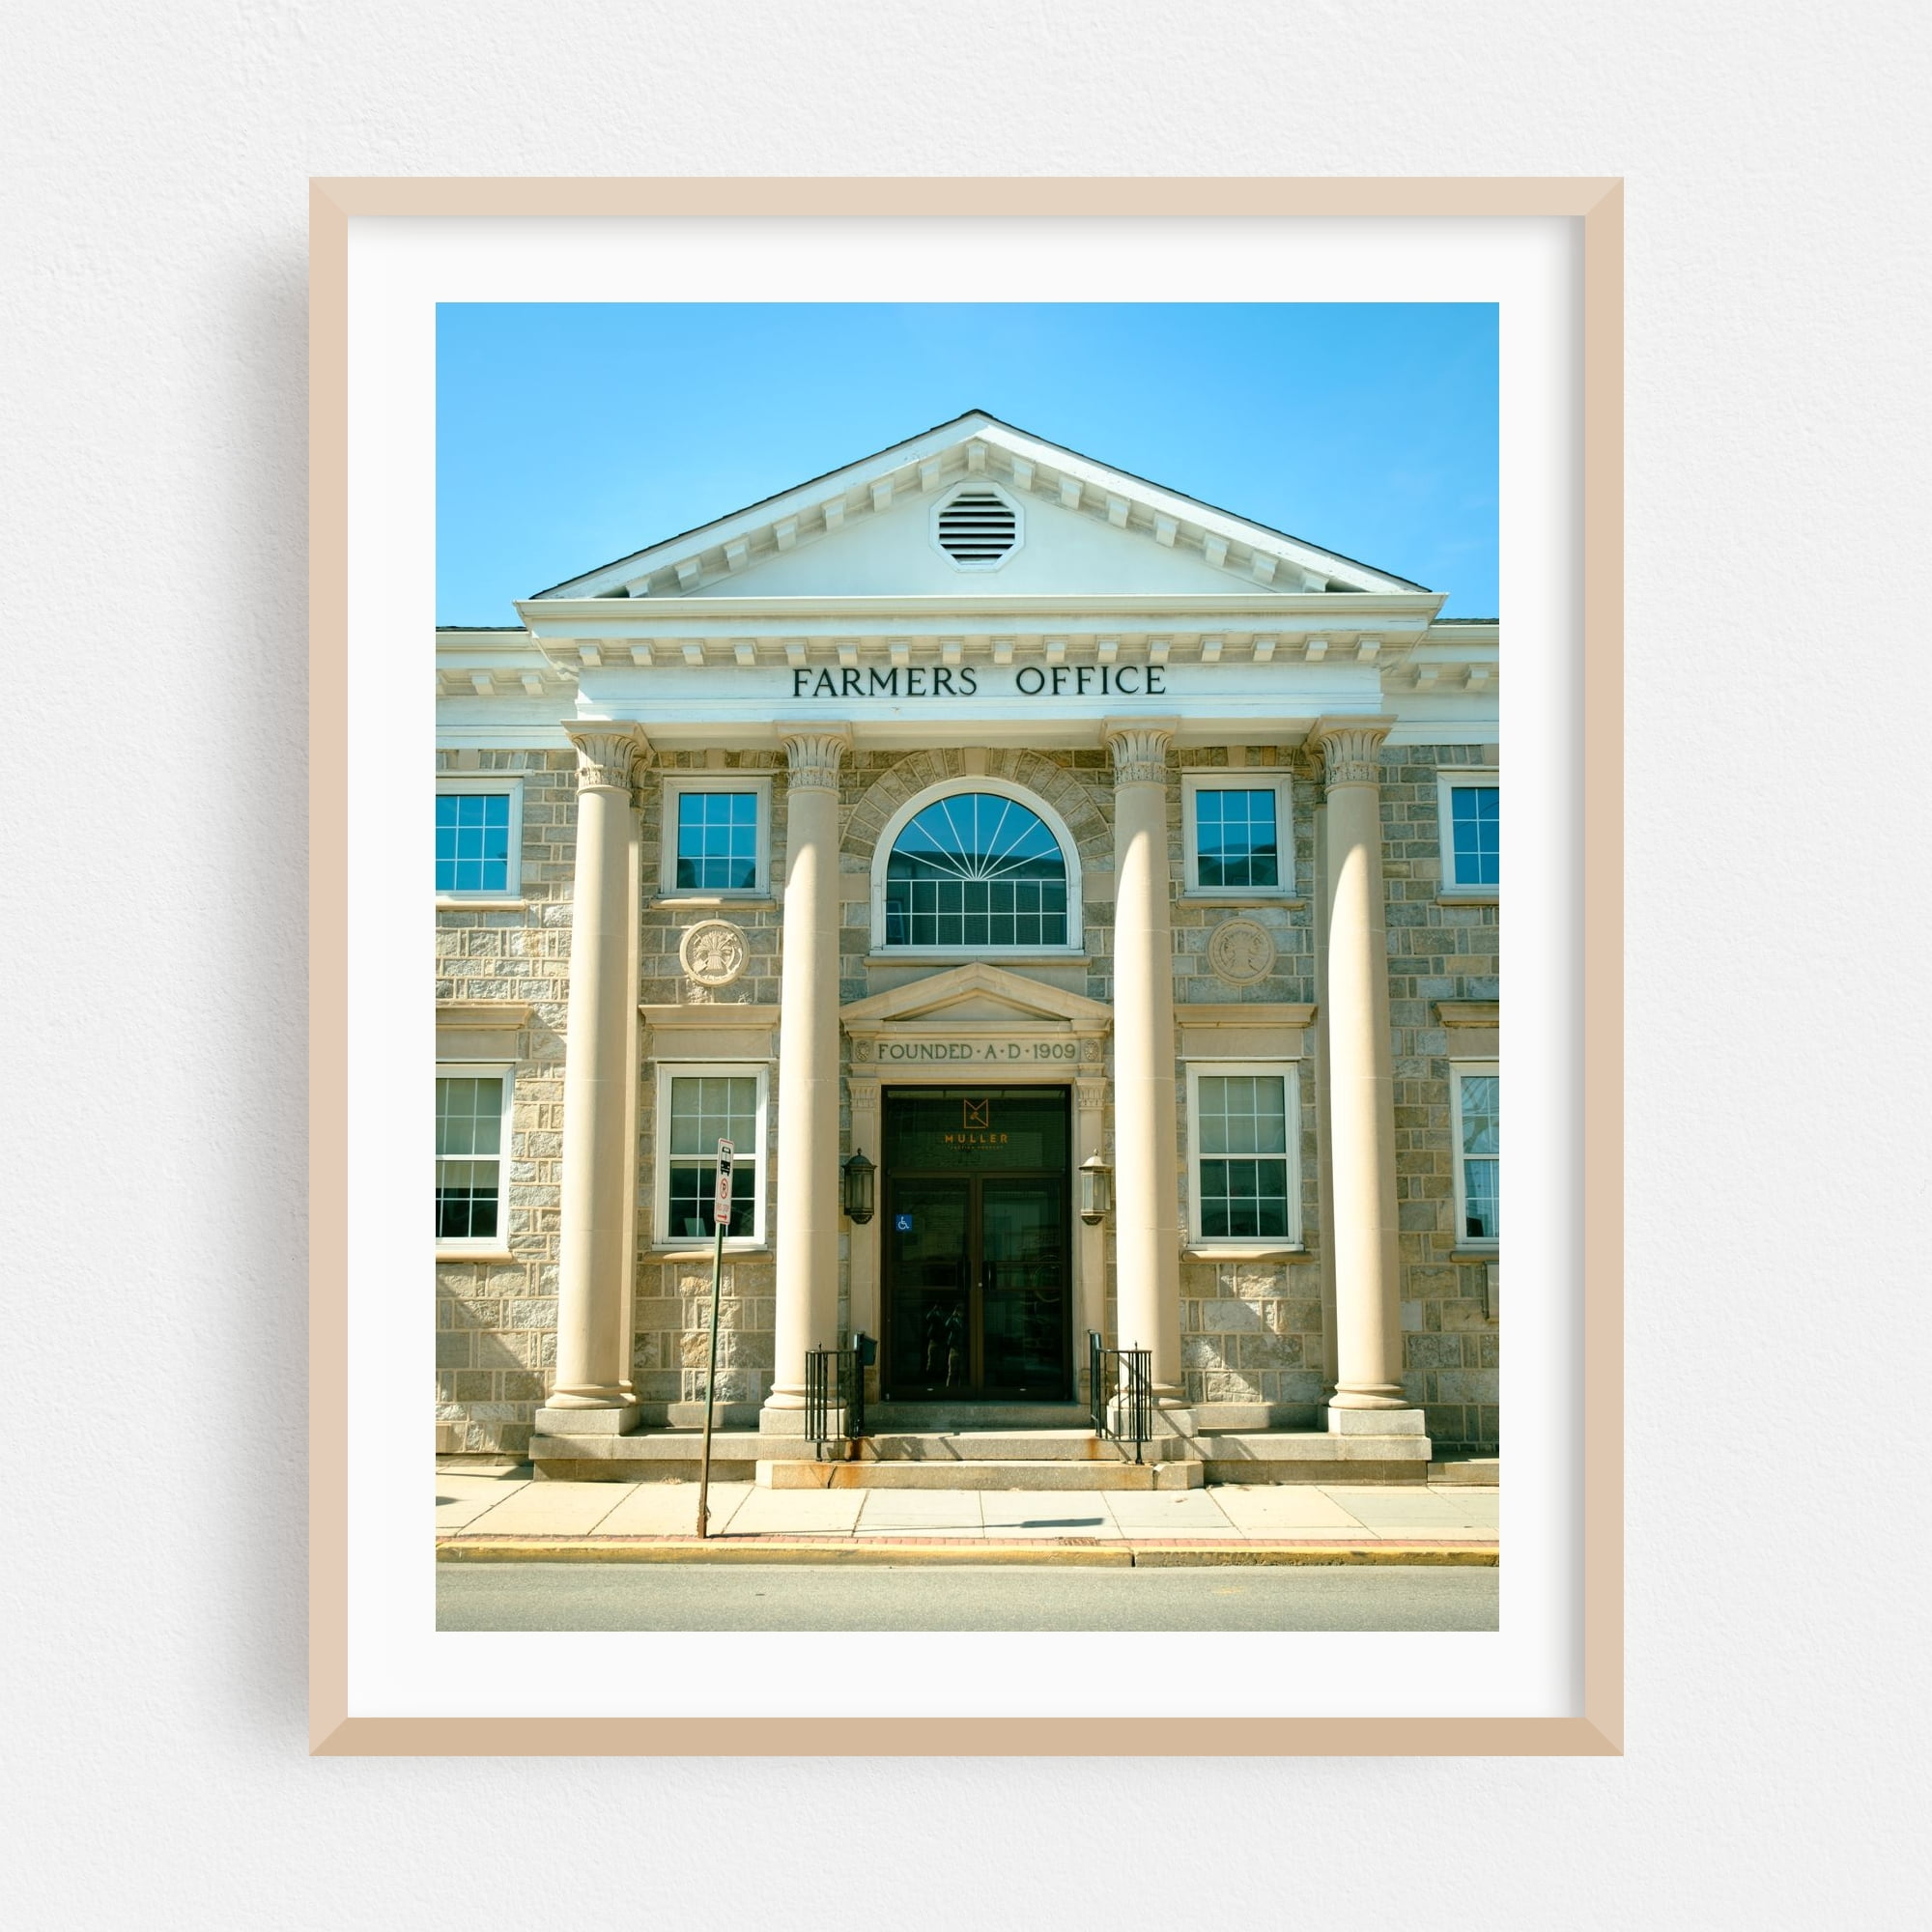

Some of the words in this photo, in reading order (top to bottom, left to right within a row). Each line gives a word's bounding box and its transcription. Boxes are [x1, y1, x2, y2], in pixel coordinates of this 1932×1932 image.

[792, 667, 978, 696] FARMERS
[1015, 666, 1166, 696] OFFICE
[878, 1043, 973, 1060] FOUNDED
[1034, 1043, 1076, 1060] 1909
[945, 1133, 1009, 1144] MULLER
